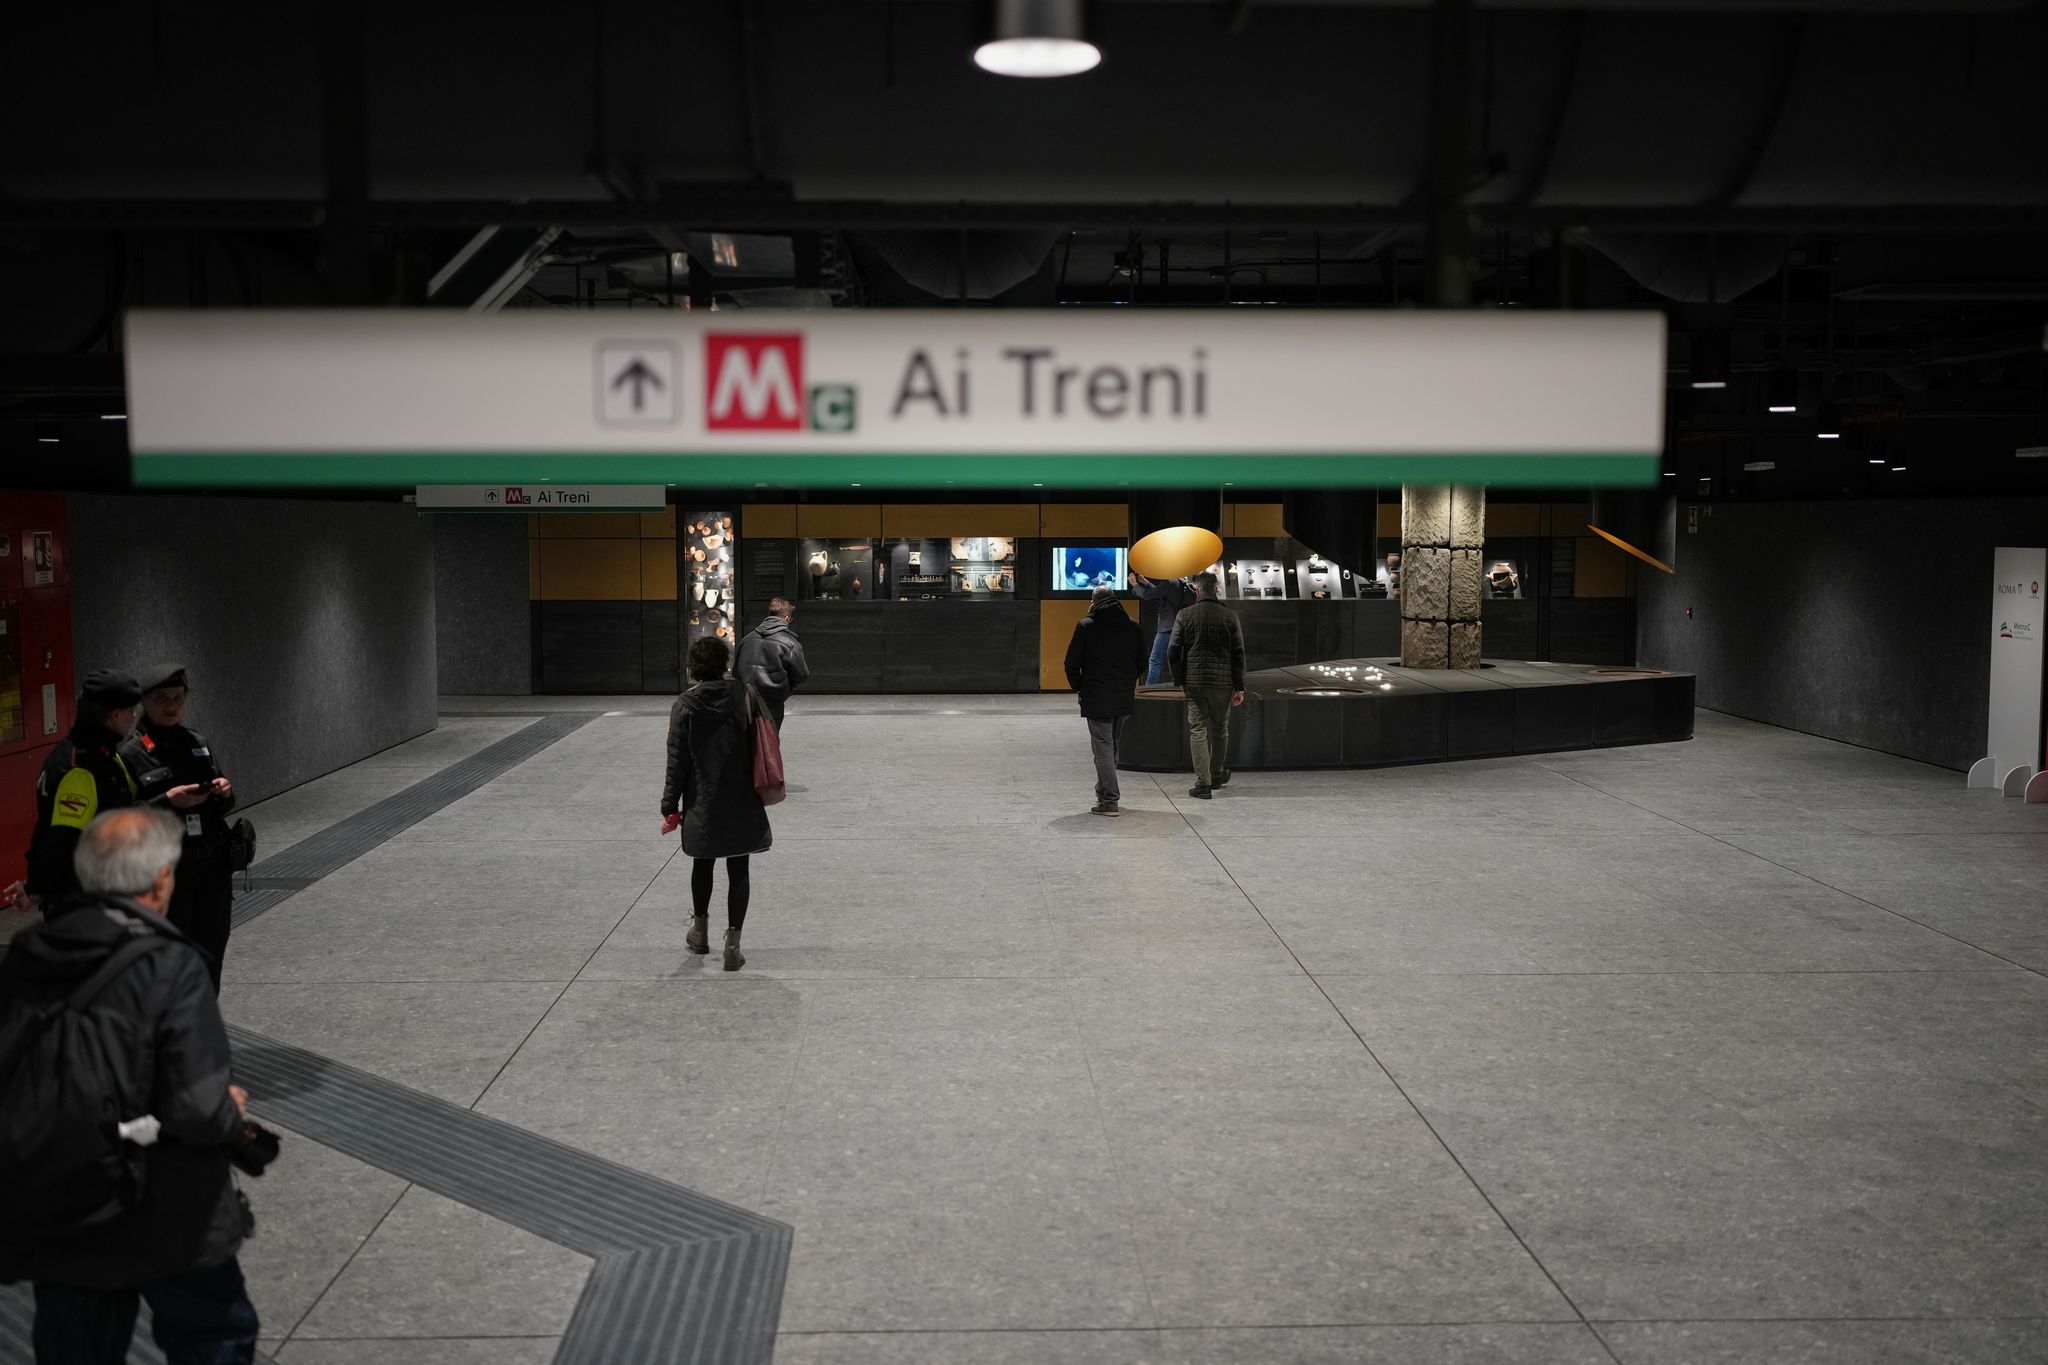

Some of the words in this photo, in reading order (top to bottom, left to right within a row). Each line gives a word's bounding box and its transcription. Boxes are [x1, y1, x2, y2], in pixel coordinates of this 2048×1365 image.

[710, 345, 799, 419] M
[812, 390, 855, 430] C
[891, 346, 971, 418] Ai
[1002, 346, 1209, 418] Treni
[507, 489, 521, 502] M
[538, 491, 551, 503] Ai
[556, 491, 590, 503] Treni
[1998, 585, 2016, 594] ROMA
